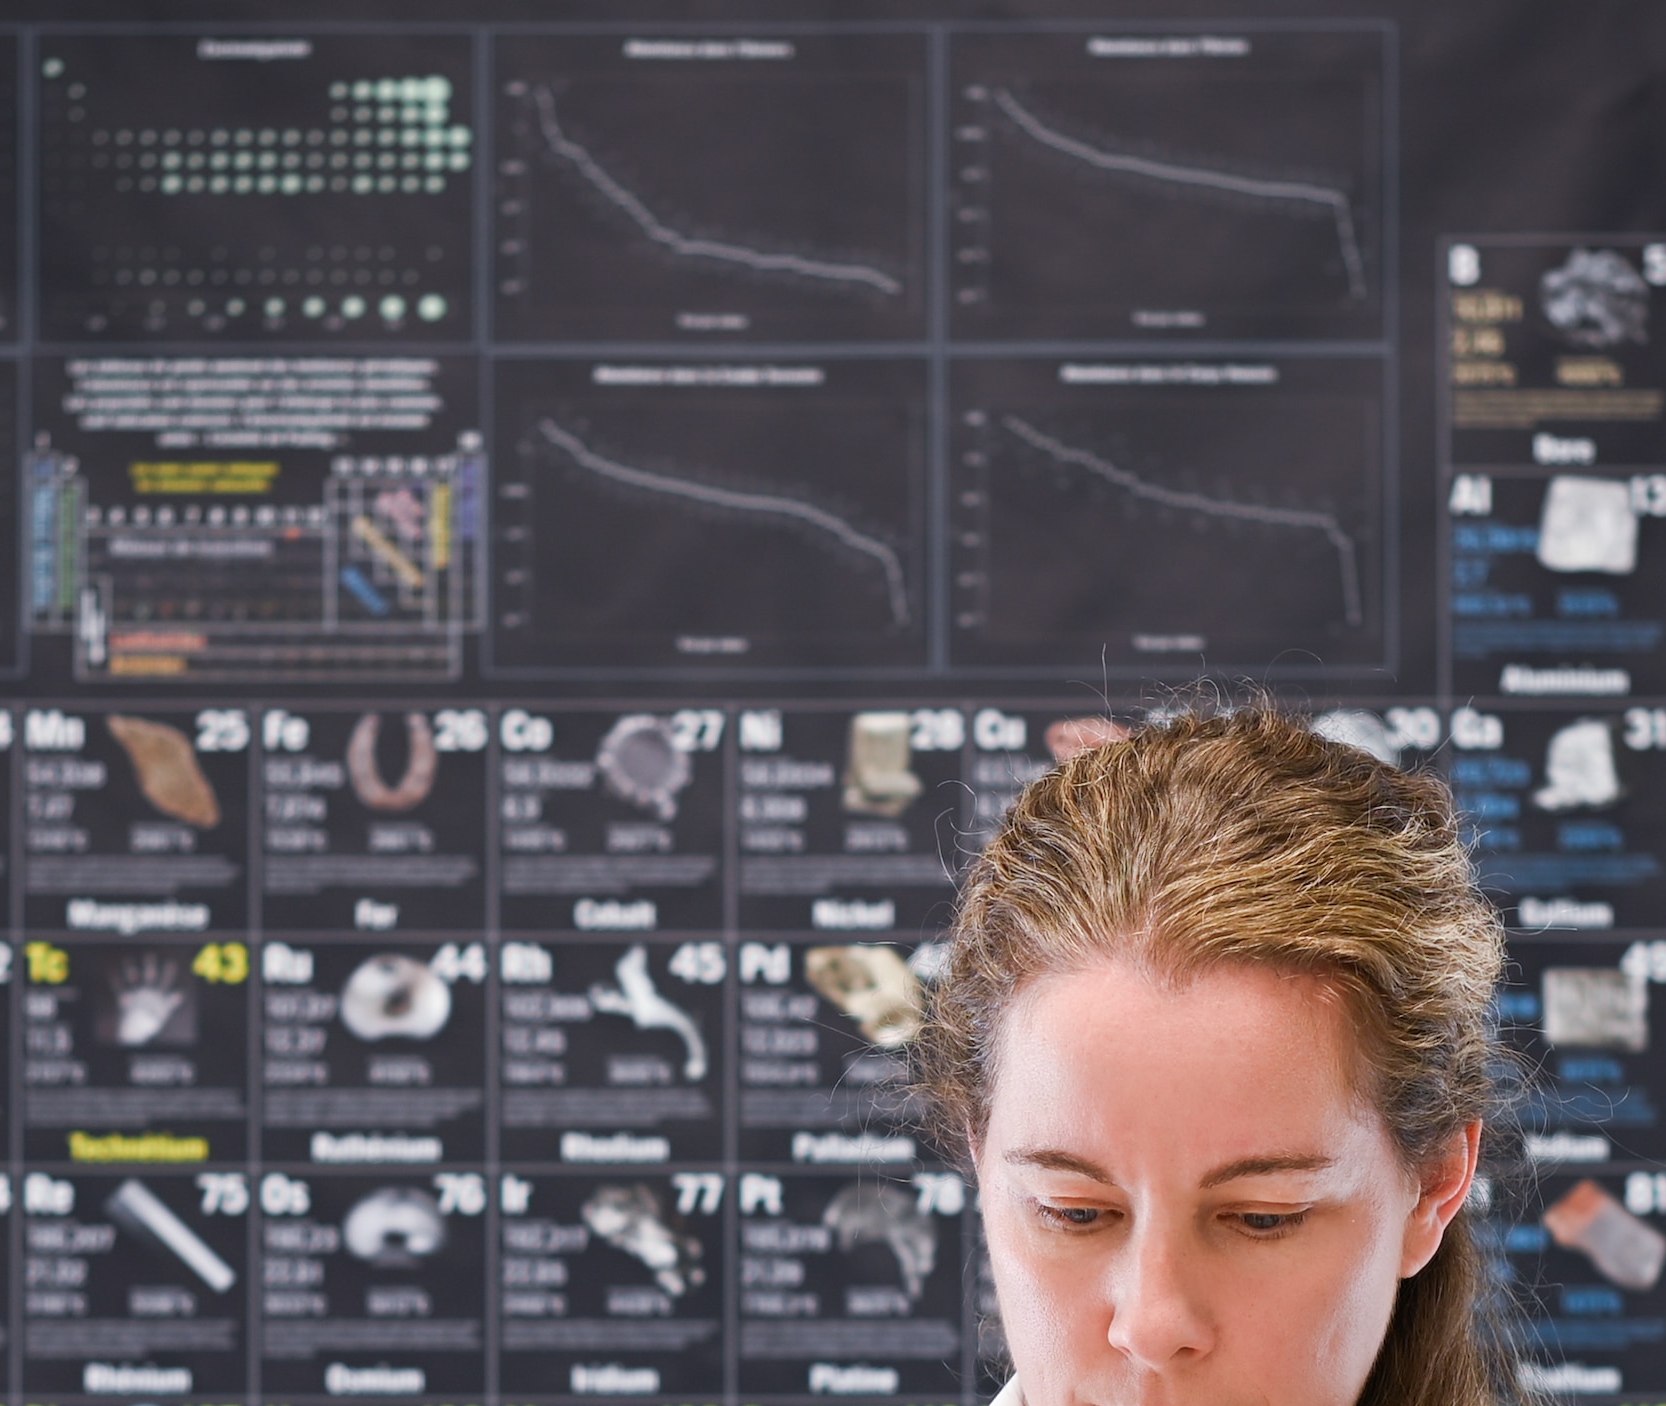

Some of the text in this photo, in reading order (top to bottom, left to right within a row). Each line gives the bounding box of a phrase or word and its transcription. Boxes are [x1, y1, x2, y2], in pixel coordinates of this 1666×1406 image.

[1449, 245, 1479, 284] B
[1450, 475, 1491, 513] Al
[25, 710, 84, 748] Mn
[195, 709, 250, 752] 25
[263, 710, 308, 750] Fe
[433, 710, 488, 752] 26
[500, 710, 552, 750] Co
[26, 942, 66, 982] Tc
[194, 943, 248, 982] 43
[262, 942, 313, 983] Ru
[430, 943, 488, 985] 44
[501, 942, 551, 981] Rh
[670, 942, 727, 983] 45
[24, 1173, 74, 1214] Re
[198, 1173, 249, 1214] 75
[260, 1173, 309, 1214] Os
[435, 1173, 486, 1216] 76
[501, 1174, 530, 1213] Ir
[673, 1173, 725, 1213] 77
[740, 1173, 781, 1214] Pt
